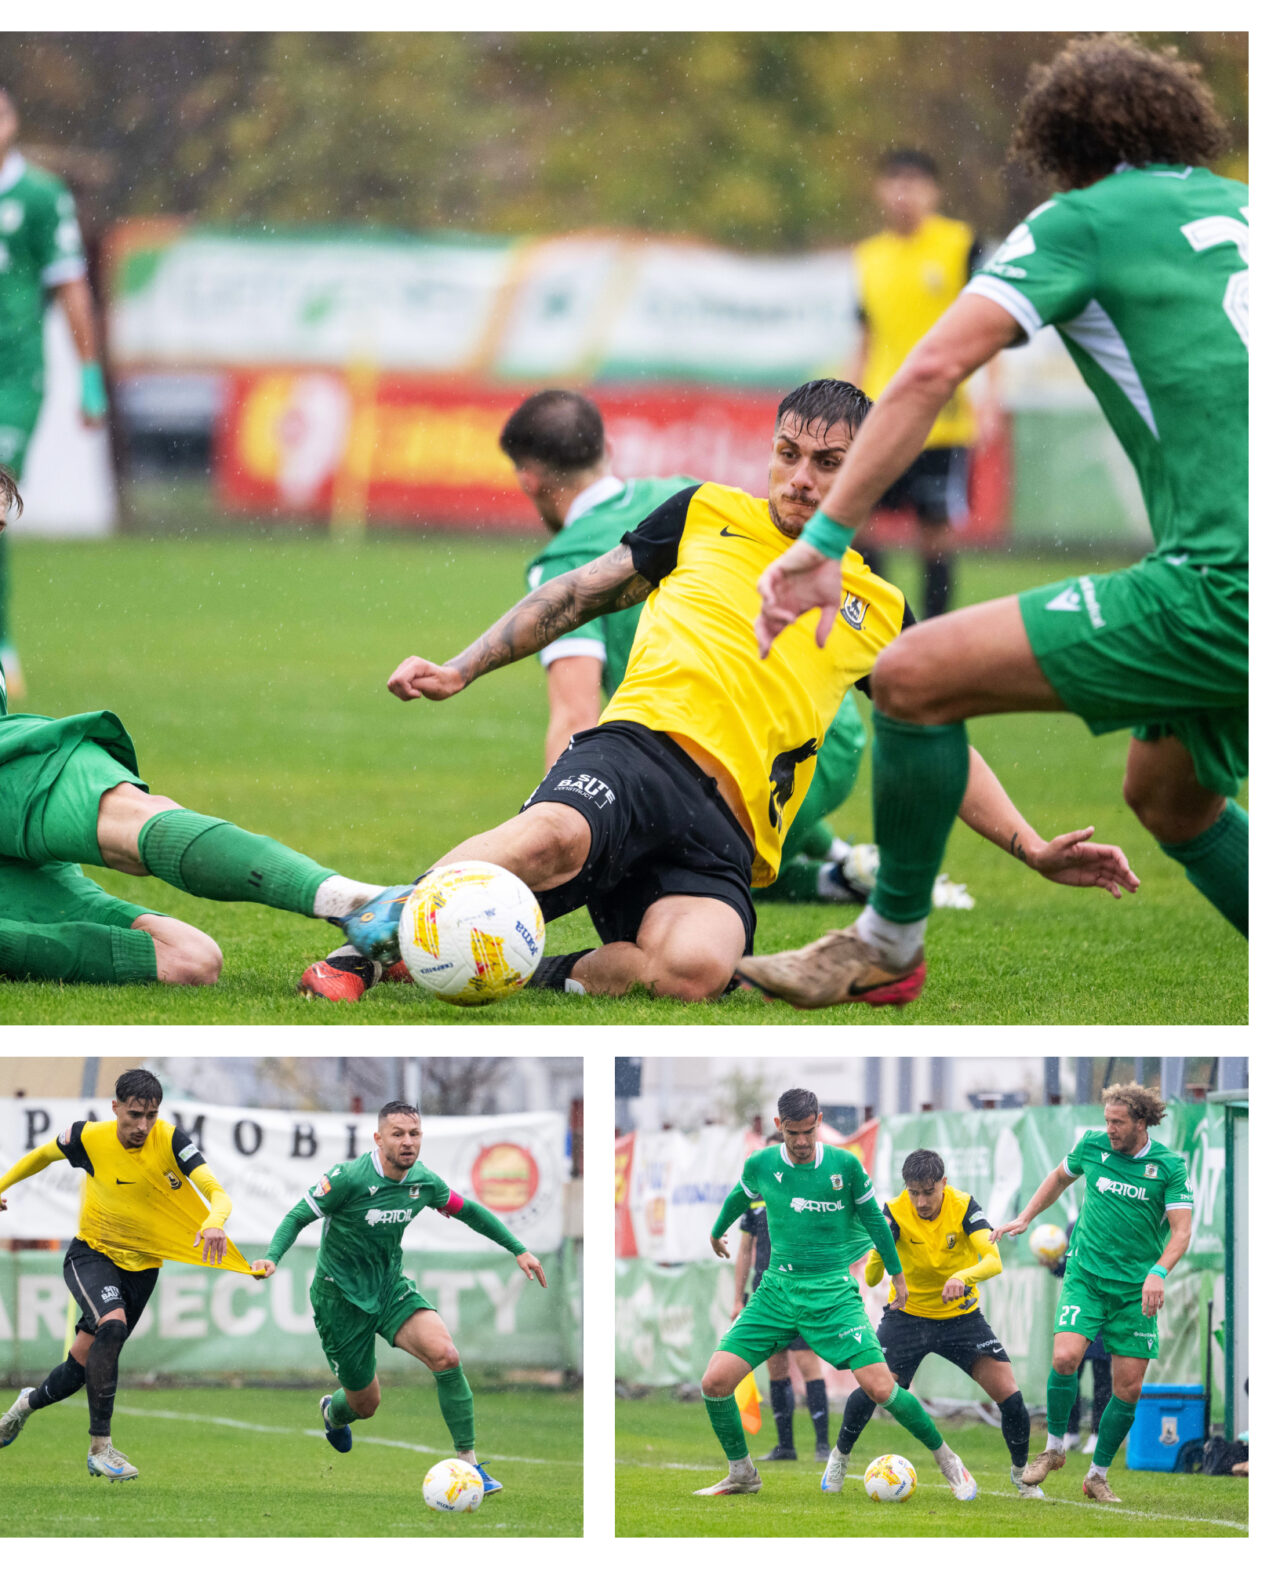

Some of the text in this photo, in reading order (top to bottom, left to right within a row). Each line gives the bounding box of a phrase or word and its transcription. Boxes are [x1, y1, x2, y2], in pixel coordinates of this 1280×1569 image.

[558, 777, 600, 796] BAU
[577, 774, 616, 805] SITE
[1058, 1305, 1081, 1326] 27
